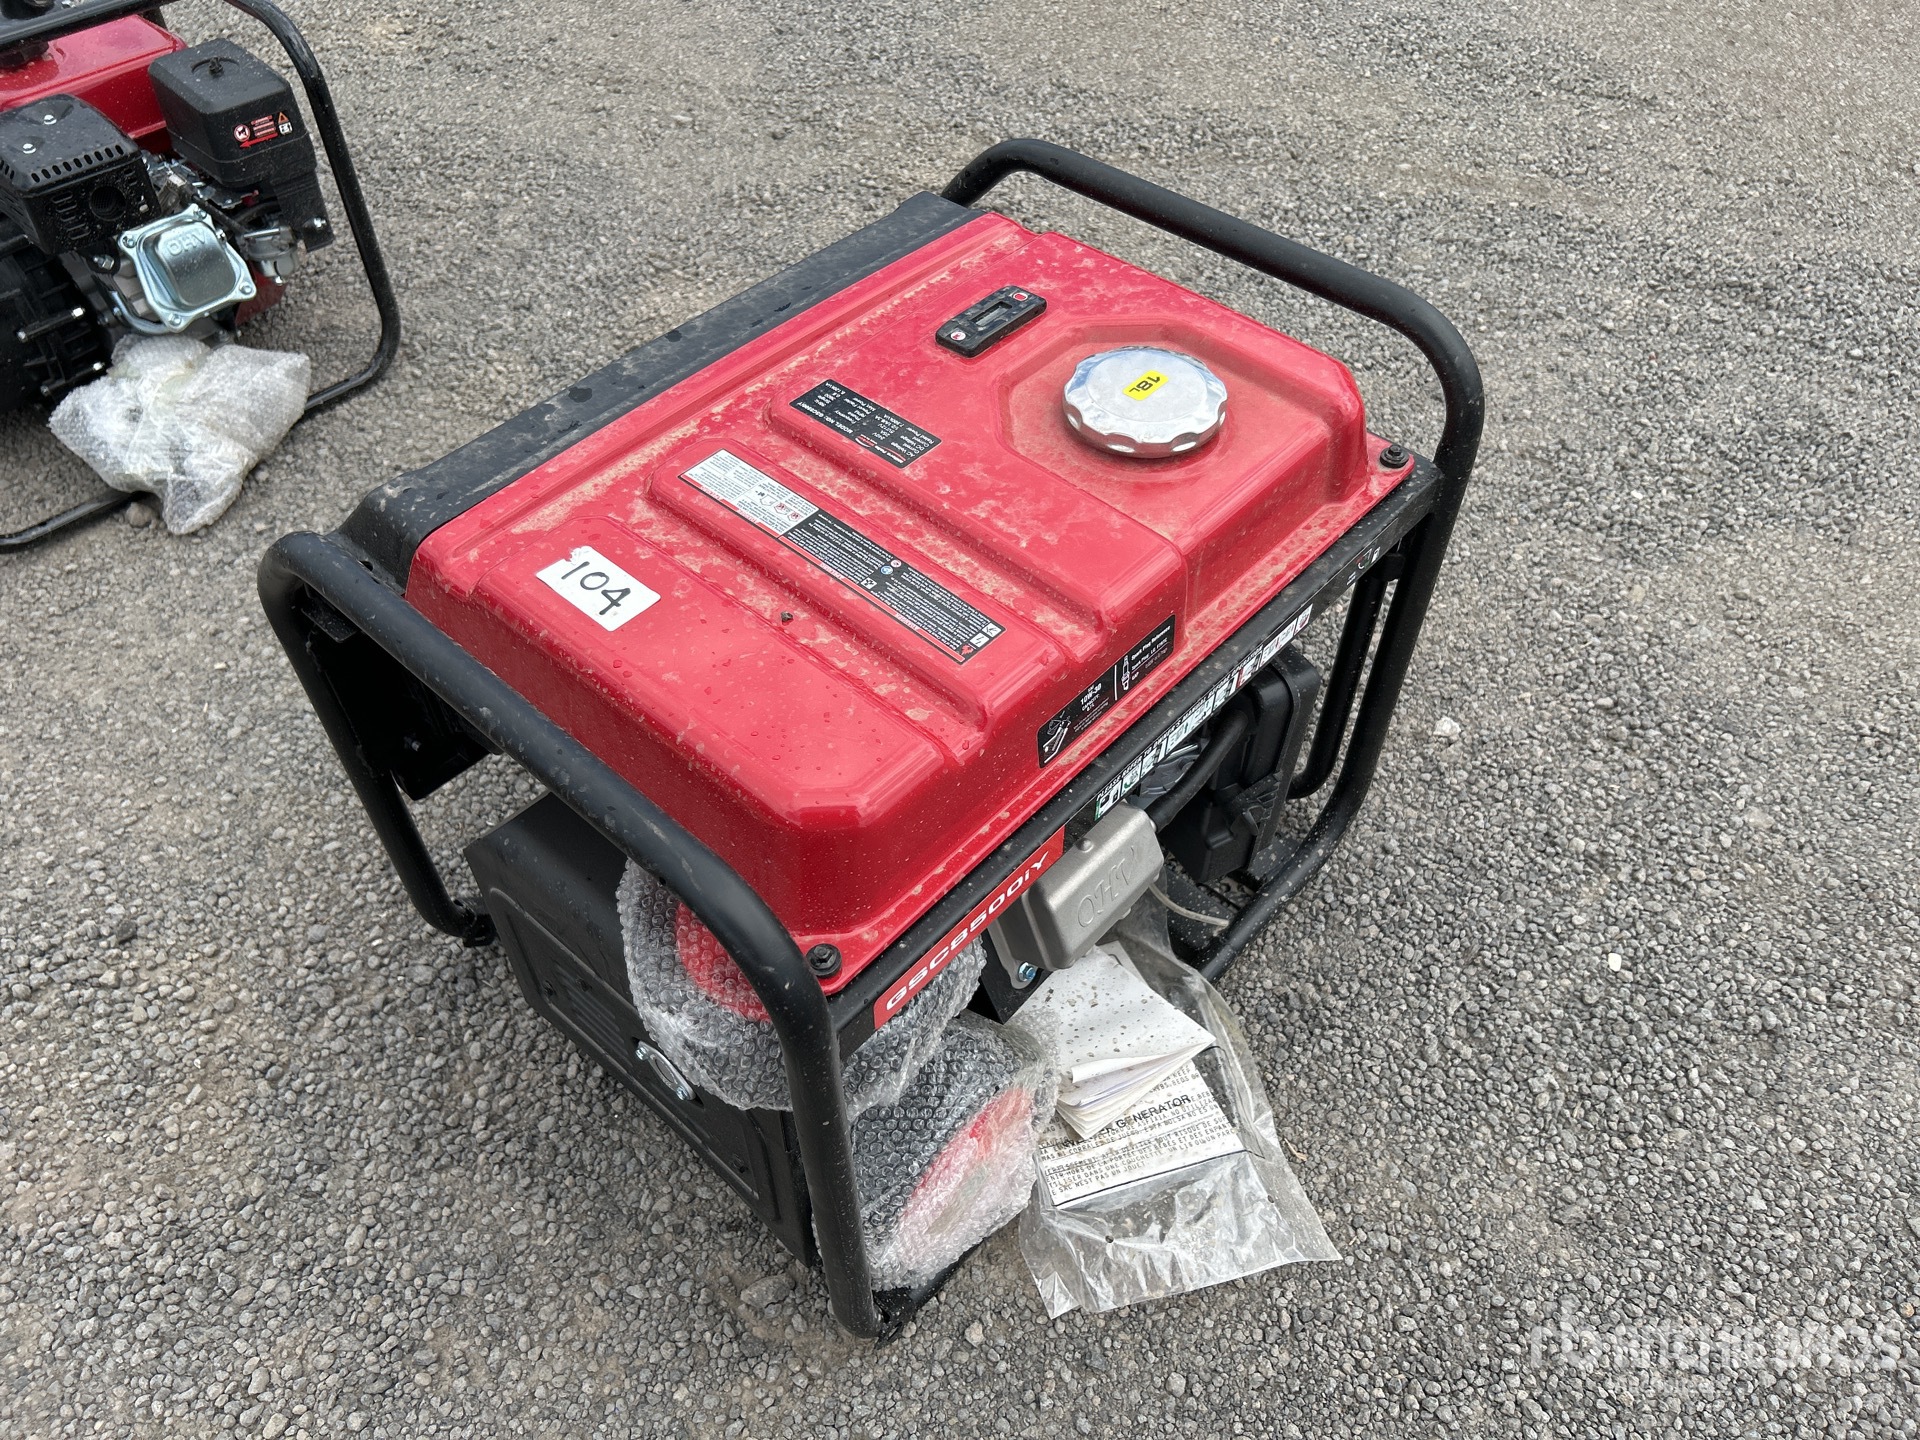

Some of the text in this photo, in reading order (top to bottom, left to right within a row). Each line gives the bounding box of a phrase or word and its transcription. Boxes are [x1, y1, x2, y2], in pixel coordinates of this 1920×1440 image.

[165, 228, 208, 256] OHV
[1129, 376, 1160, 392] 18L
[852, 397, 866, 406] Power
[847, 411, 861, 420] Phase
[856, 405, 871, 414] Power
[834, 410, 856, 423] Frequency
[835, 421, 852, 433] MODEL
[906, 427, 920, 436] Power
[900, 435, 916, 446] Voltage
[912, 436, 929, 447] Current
[919, 434, 934, 444] Rated
[890, 441, 906, 453] Voltage
[902, 442, 919, 453] Current
[561, 561, 631, 616] 104
[1131, 648, 1142, 660] Spark
[1142, 641, 1151, 651] Plug
[1151, 625, 1170, 643] Reference
[1081, 683, 1101, 705] 10W-30
[1096, 775, 1120, 800] PLEASE
[1121, 755, 1142, 777] REFER
[1143, 746, 1151, 757] TO
[1181, 697, 1205, 721] MANUAL
[1208, 674, 1230, 697] BEFORE
[1078, 845, 1140, 928] OHV
[886, 851, 1049, 1011] GSC8500iY
[1115, 1095, 1190, 1127] GENERATOR
[1173, 1124, 1199, 1136] RISQUE
[1066, 1166, 1084, 1174] HORS
[1083, 1167, 1102, 1177] DANS
